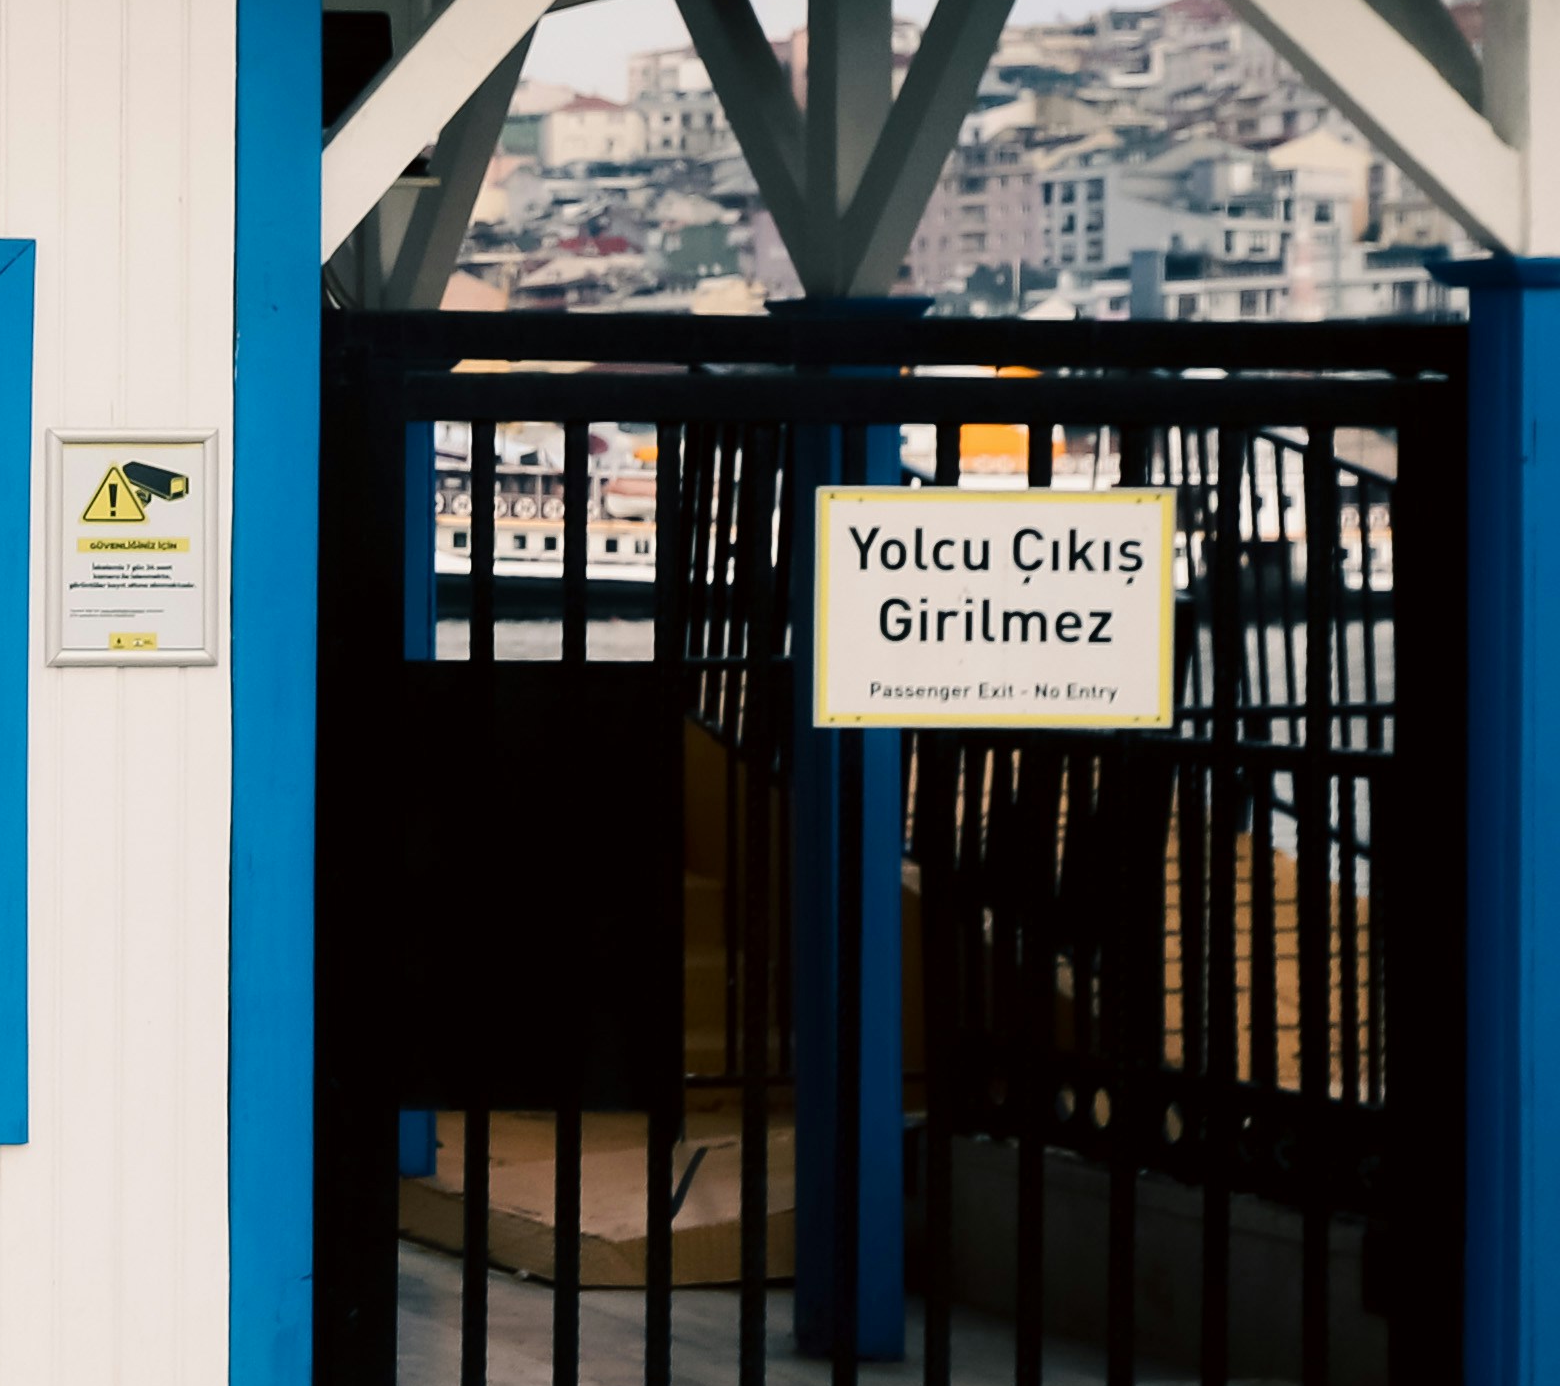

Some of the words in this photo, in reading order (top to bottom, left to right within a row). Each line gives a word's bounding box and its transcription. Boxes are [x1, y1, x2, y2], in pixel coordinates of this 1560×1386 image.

[850, 527, 989, 571] Yolcu
[1013, 529, 1142, 584] Çıkış
[880, 599, 1112, 642] Girilmez
[870, 681, 970, 702] Passenger
[978, 683, 1013, 698] Exit
[1035, 684, 1060, 698] No
[1066, 683, 1117, 703] Entry
